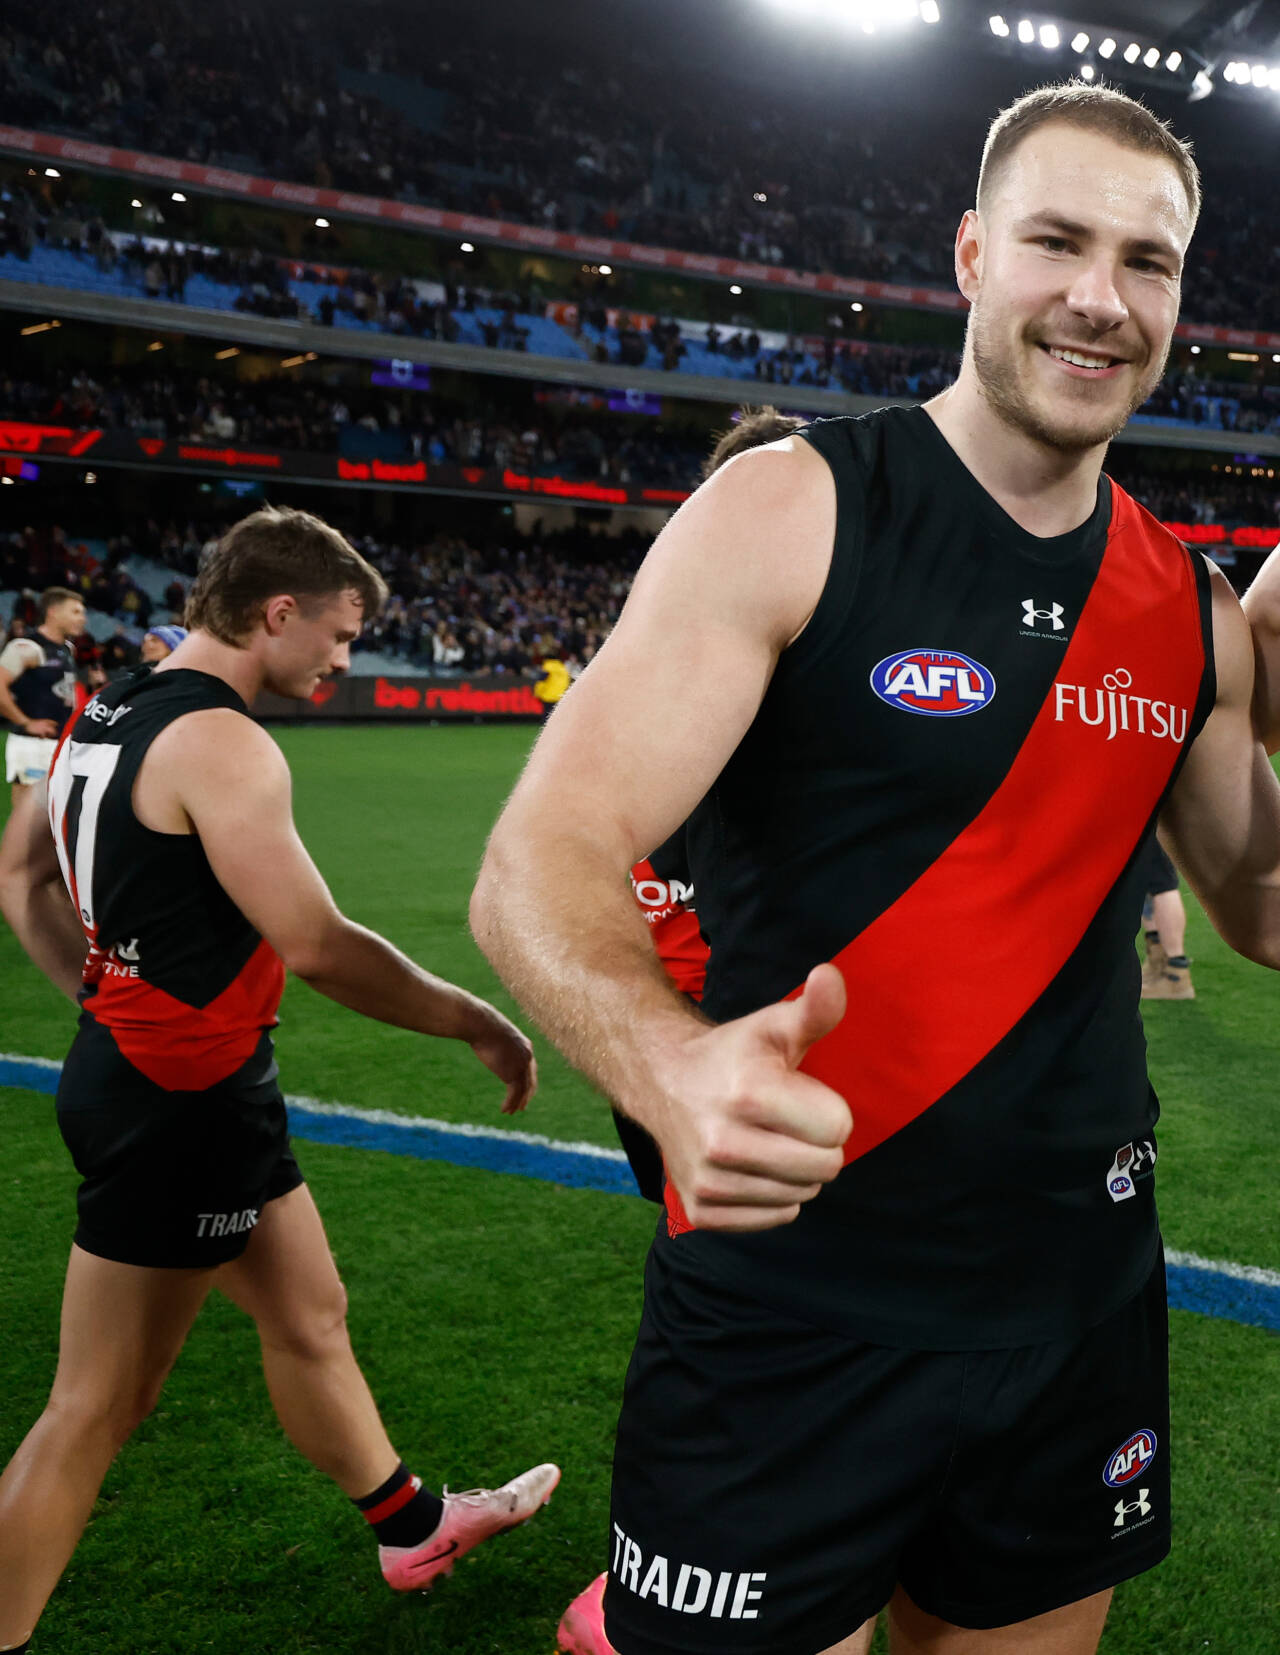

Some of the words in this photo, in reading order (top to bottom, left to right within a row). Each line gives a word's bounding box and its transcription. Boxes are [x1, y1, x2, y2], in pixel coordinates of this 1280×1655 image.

[883, 662, 986, 702] AFL
[1054, 682, 1188, 744] FUJITSU
[1112, 1179, 1130, 1192] AFL
[1108, 1437, 1153, 1483] AFL
[612, 1520, 768, 1620] TRADIE
